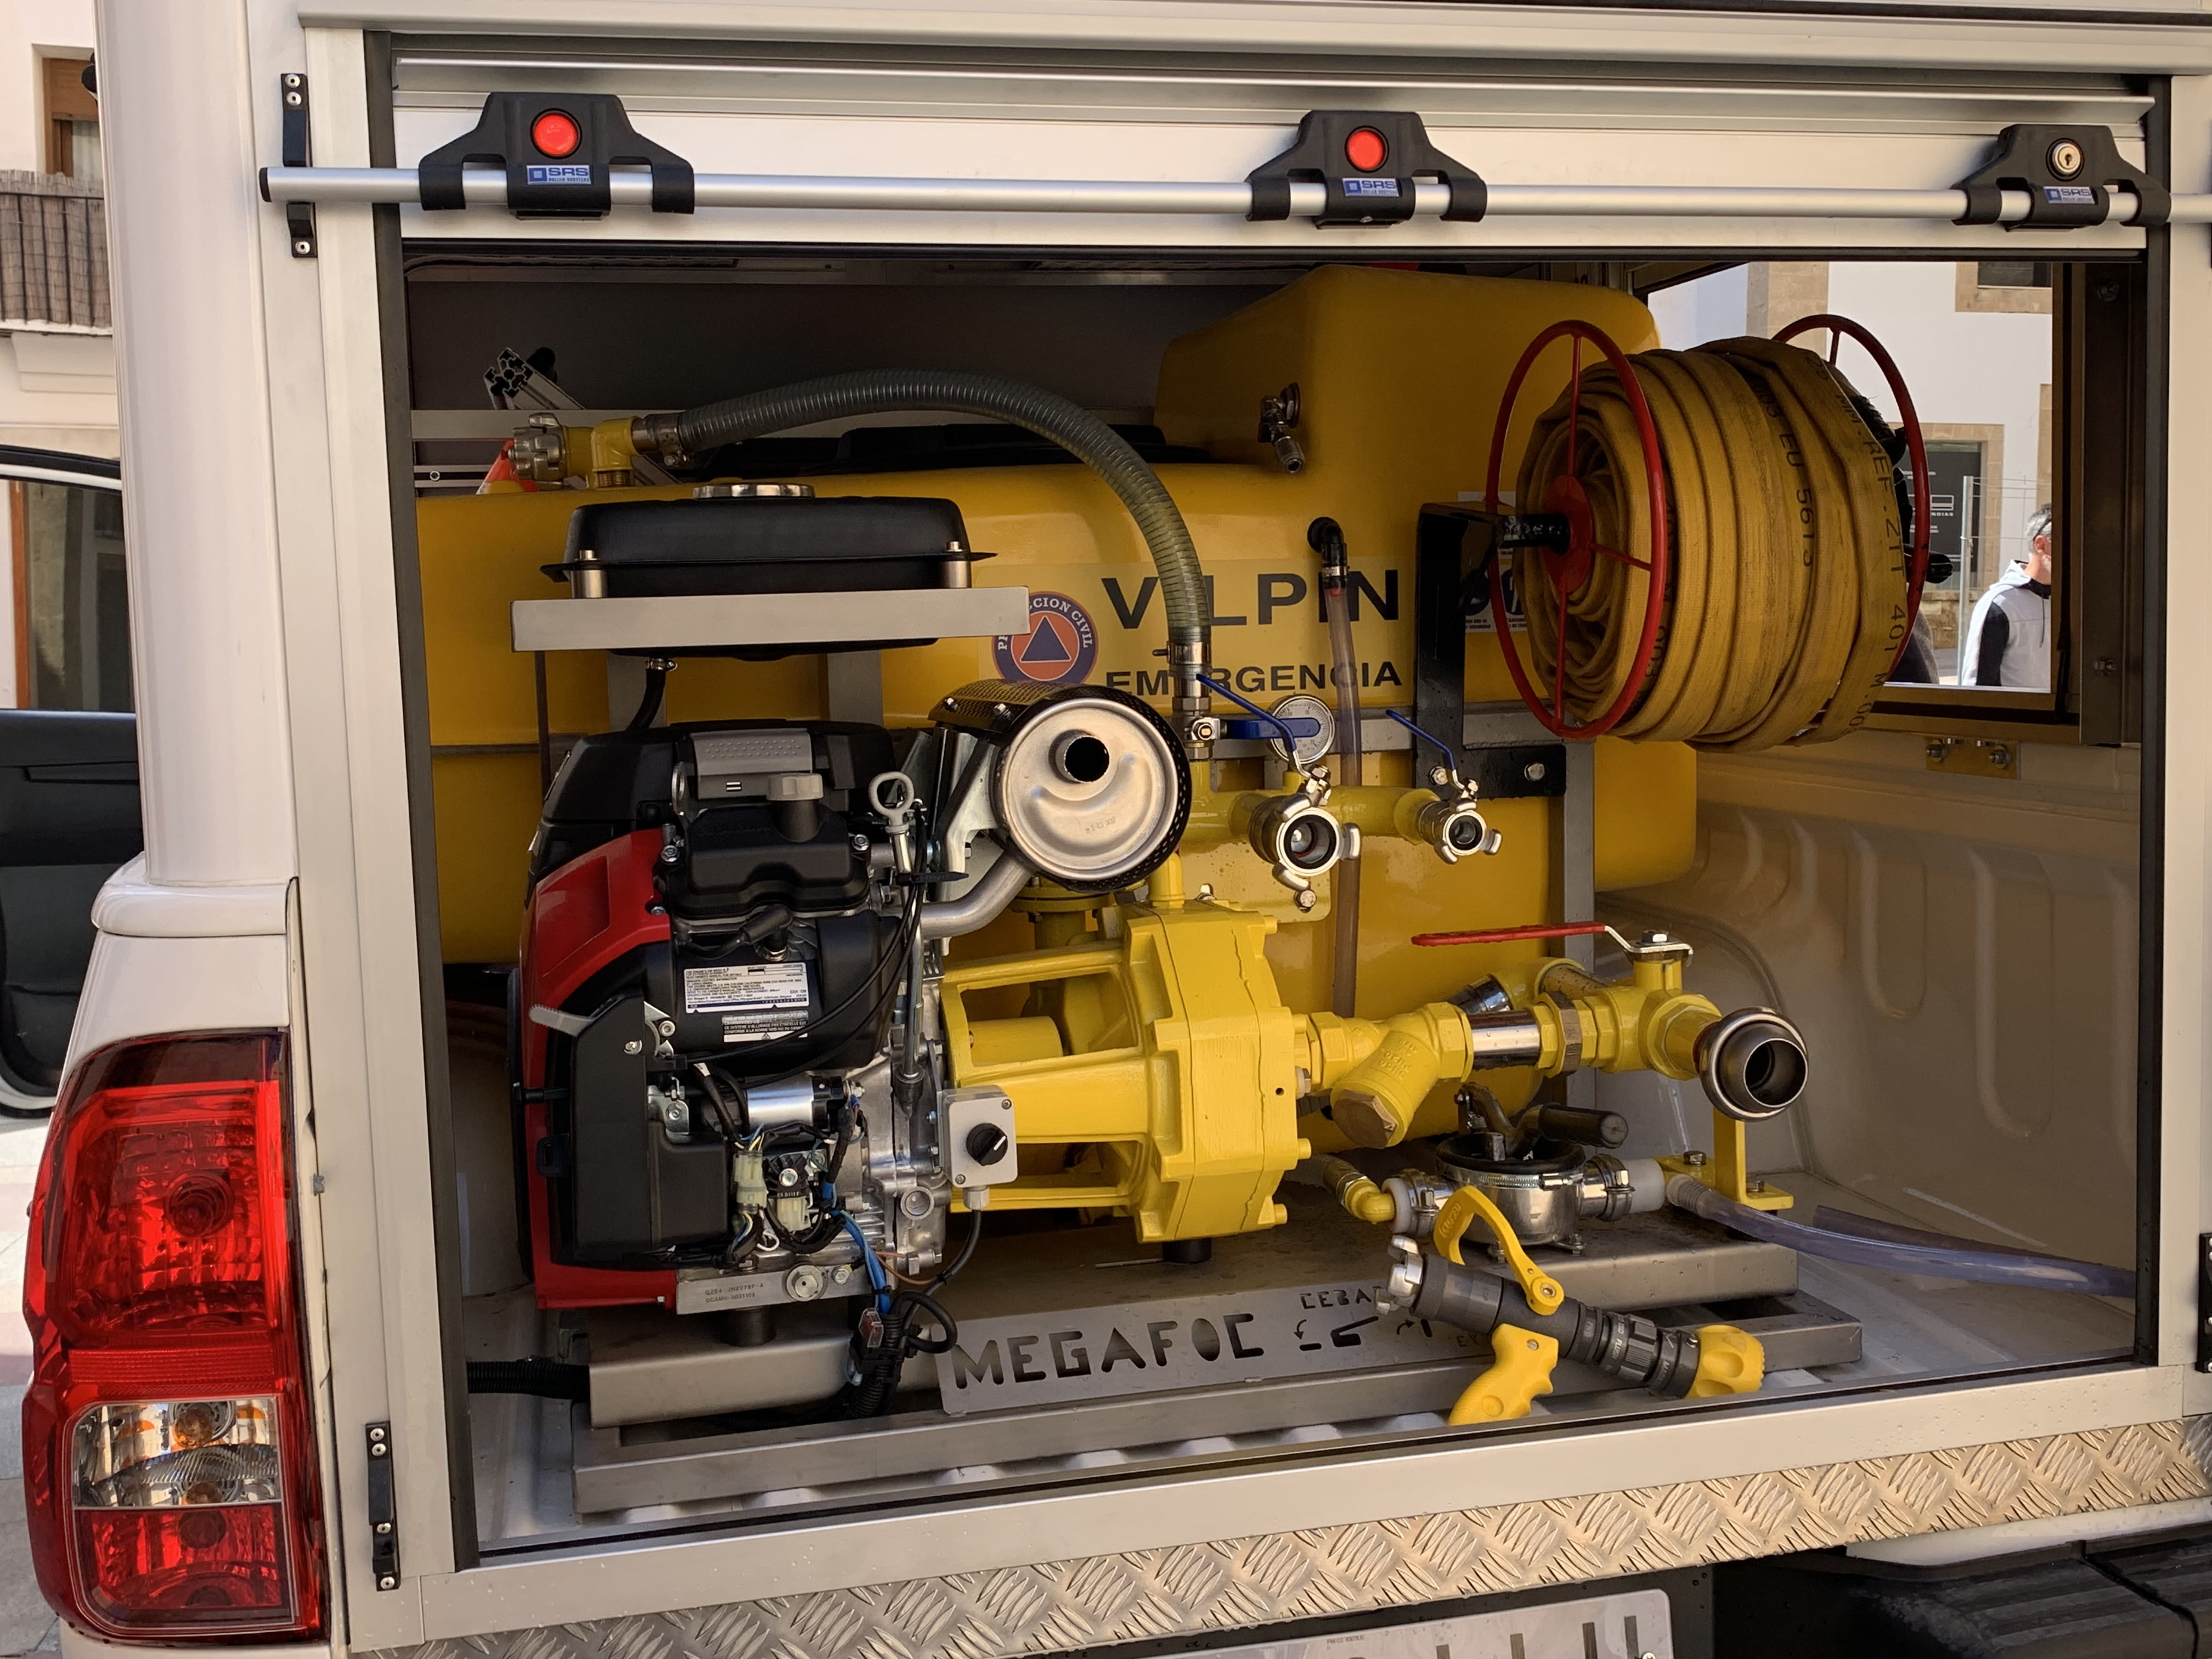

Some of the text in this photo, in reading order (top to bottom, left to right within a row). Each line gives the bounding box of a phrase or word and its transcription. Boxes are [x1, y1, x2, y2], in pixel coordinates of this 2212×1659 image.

[548, 167, 589, 176] SRS
[1361, 180, 1396, 189] SRS
[1101, 569, 1399, 629] VLPIN
[1071, 610, 1093, 648] CIVIL
[1106, 661, 1402, 696] EMRGENCIA
[950, 1313, 1265, 1389] MEGAFOC
